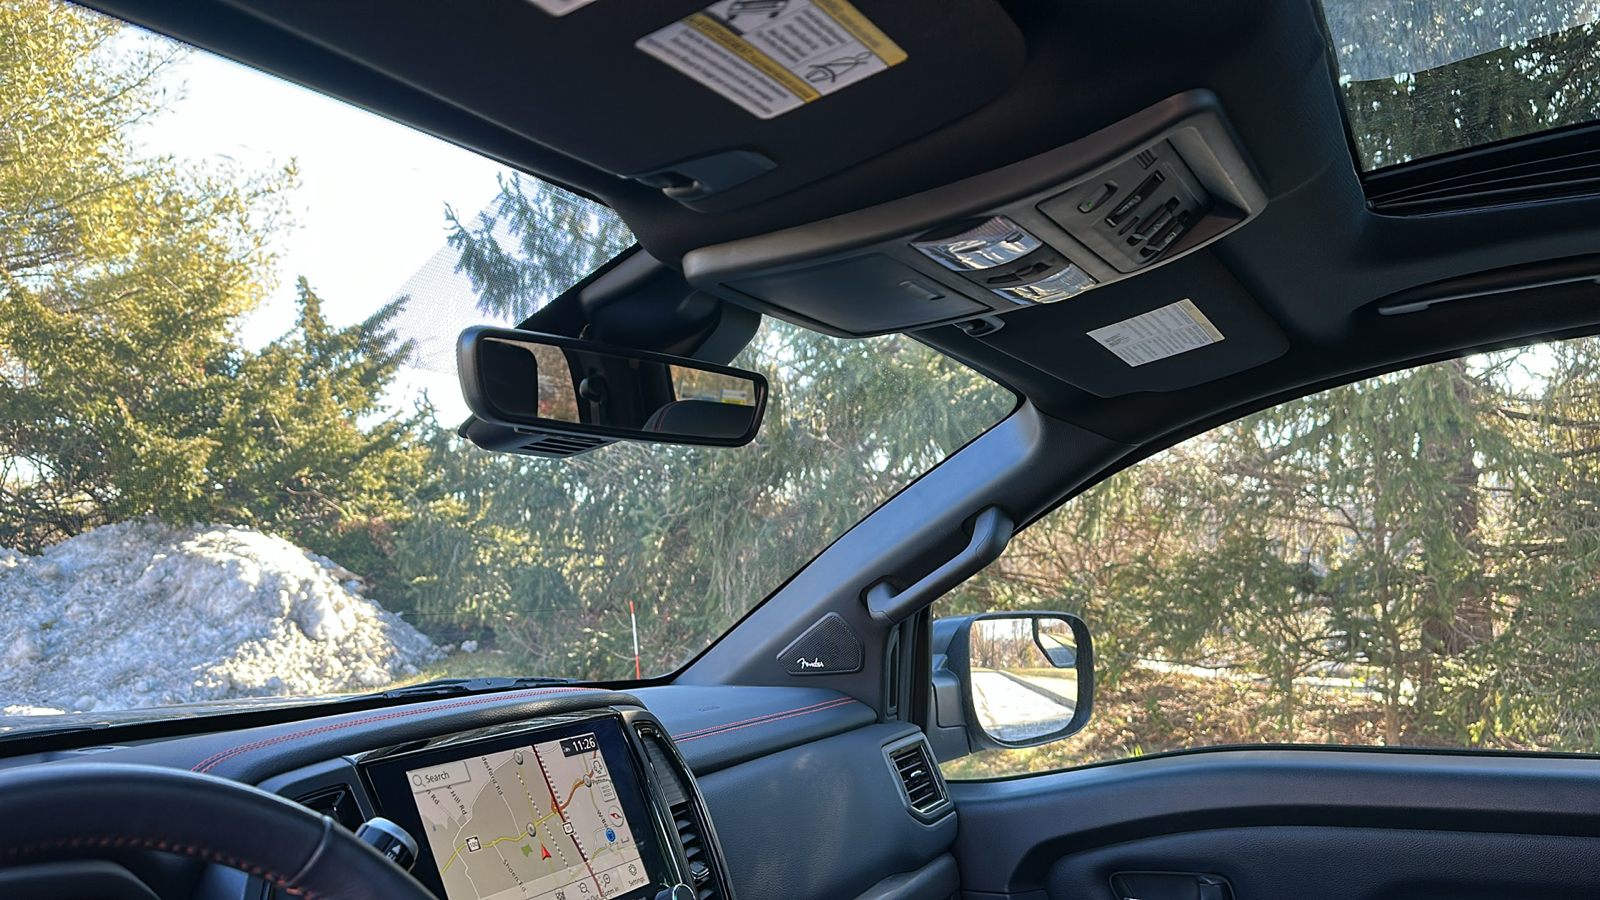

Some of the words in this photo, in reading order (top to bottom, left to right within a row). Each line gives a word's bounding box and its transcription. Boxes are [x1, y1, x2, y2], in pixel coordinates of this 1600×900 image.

[796, 657, 824, 669] Fender
[572, 737, 596, 752] 11:26
[425, 771, 450, 783] Search
[495, 785, 503, 796] Rd
[430, 794, 440, 805] Rd
[450, 790, 461, 804] Hill
[459, 804, 468, 816] Rd
[628, 877, 646, 887] Settings
